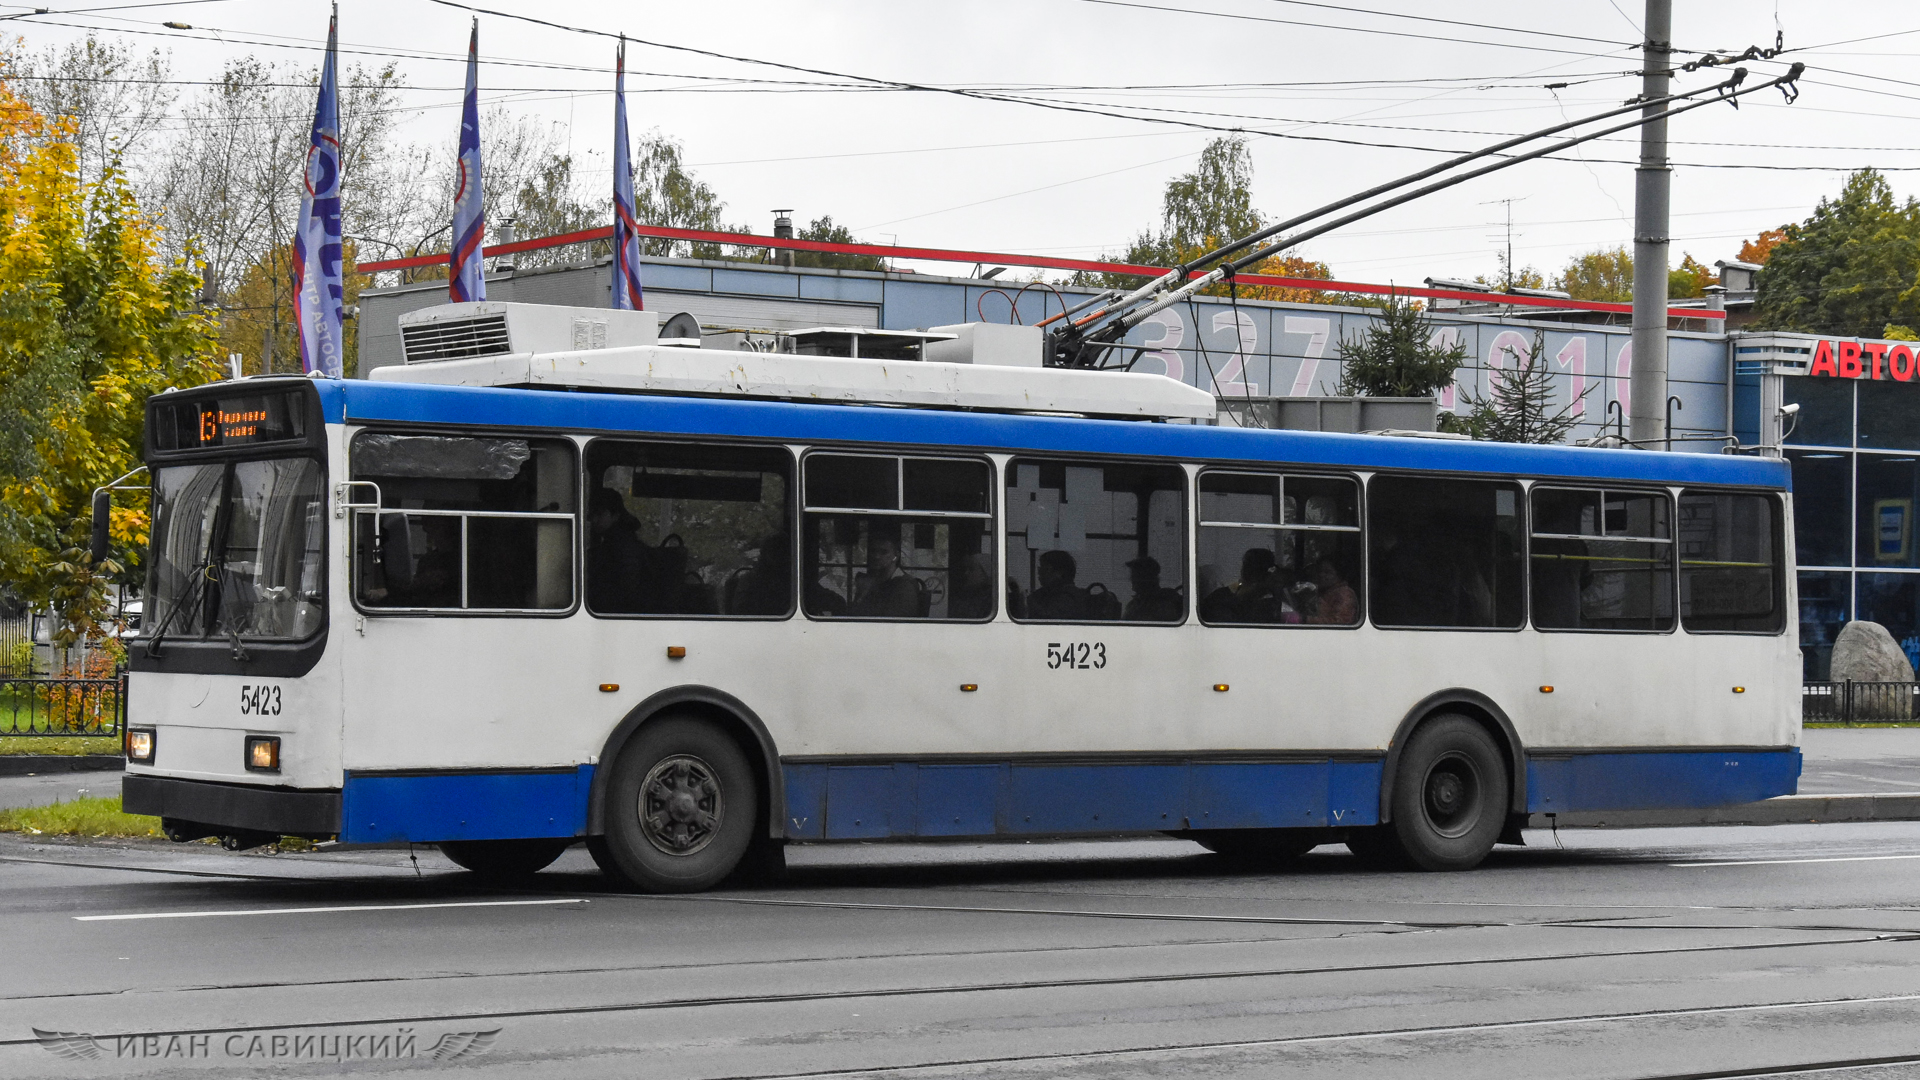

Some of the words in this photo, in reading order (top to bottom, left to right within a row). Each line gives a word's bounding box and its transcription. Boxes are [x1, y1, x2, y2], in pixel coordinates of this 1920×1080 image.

[1810, 339, 1920, 382] АВТО
[1047, 642, 1107, 669] 5423
[241, 685, 281, 715] 5423
